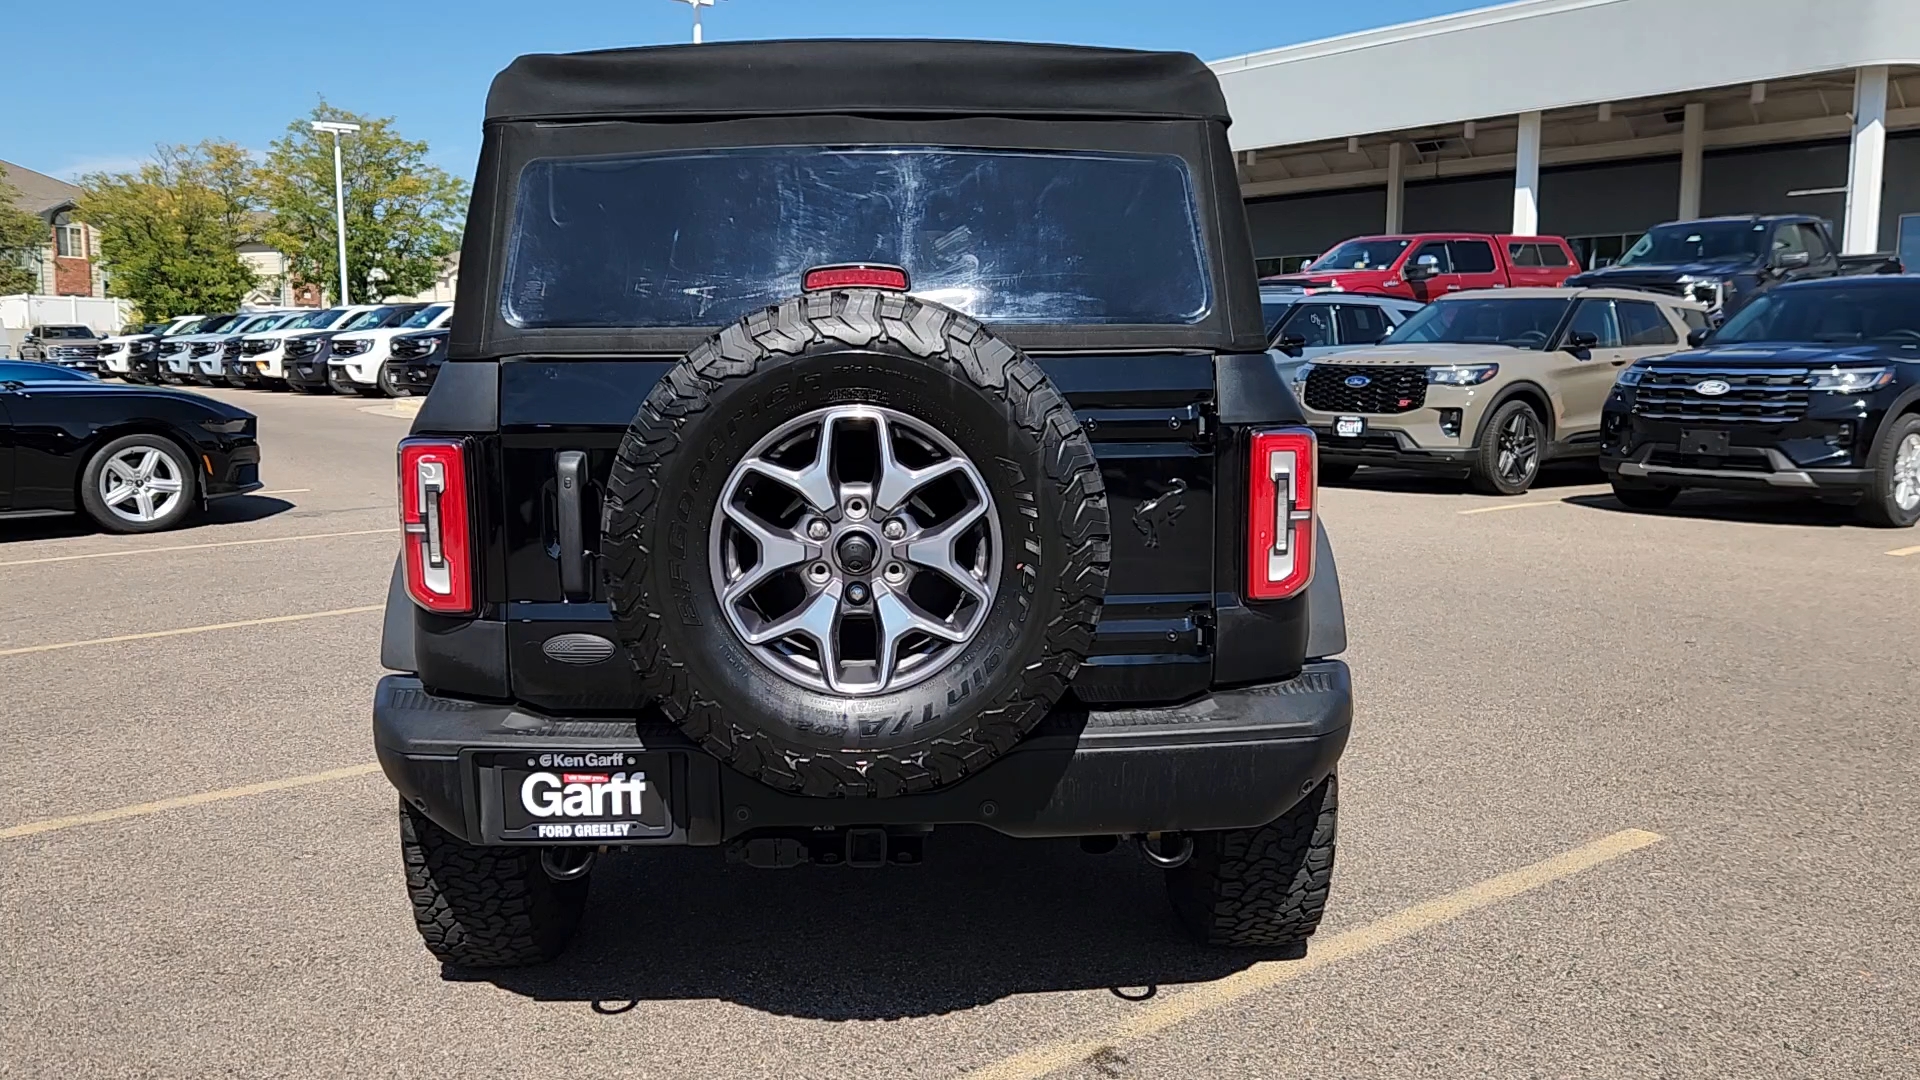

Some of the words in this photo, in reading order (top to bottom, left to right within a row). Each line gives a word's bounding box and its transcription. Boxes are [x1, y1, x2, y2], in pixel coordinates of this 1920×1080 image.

[668, 373, 824, 627] BFGoodrich
[553, 754, 584, 767] Ken
[585, 753, 624, 766] Garff
[521, 771, 646, 817] Garff
[538, 825, 571, 837] FORD
[575, 823, 630, 836] GREELEY
